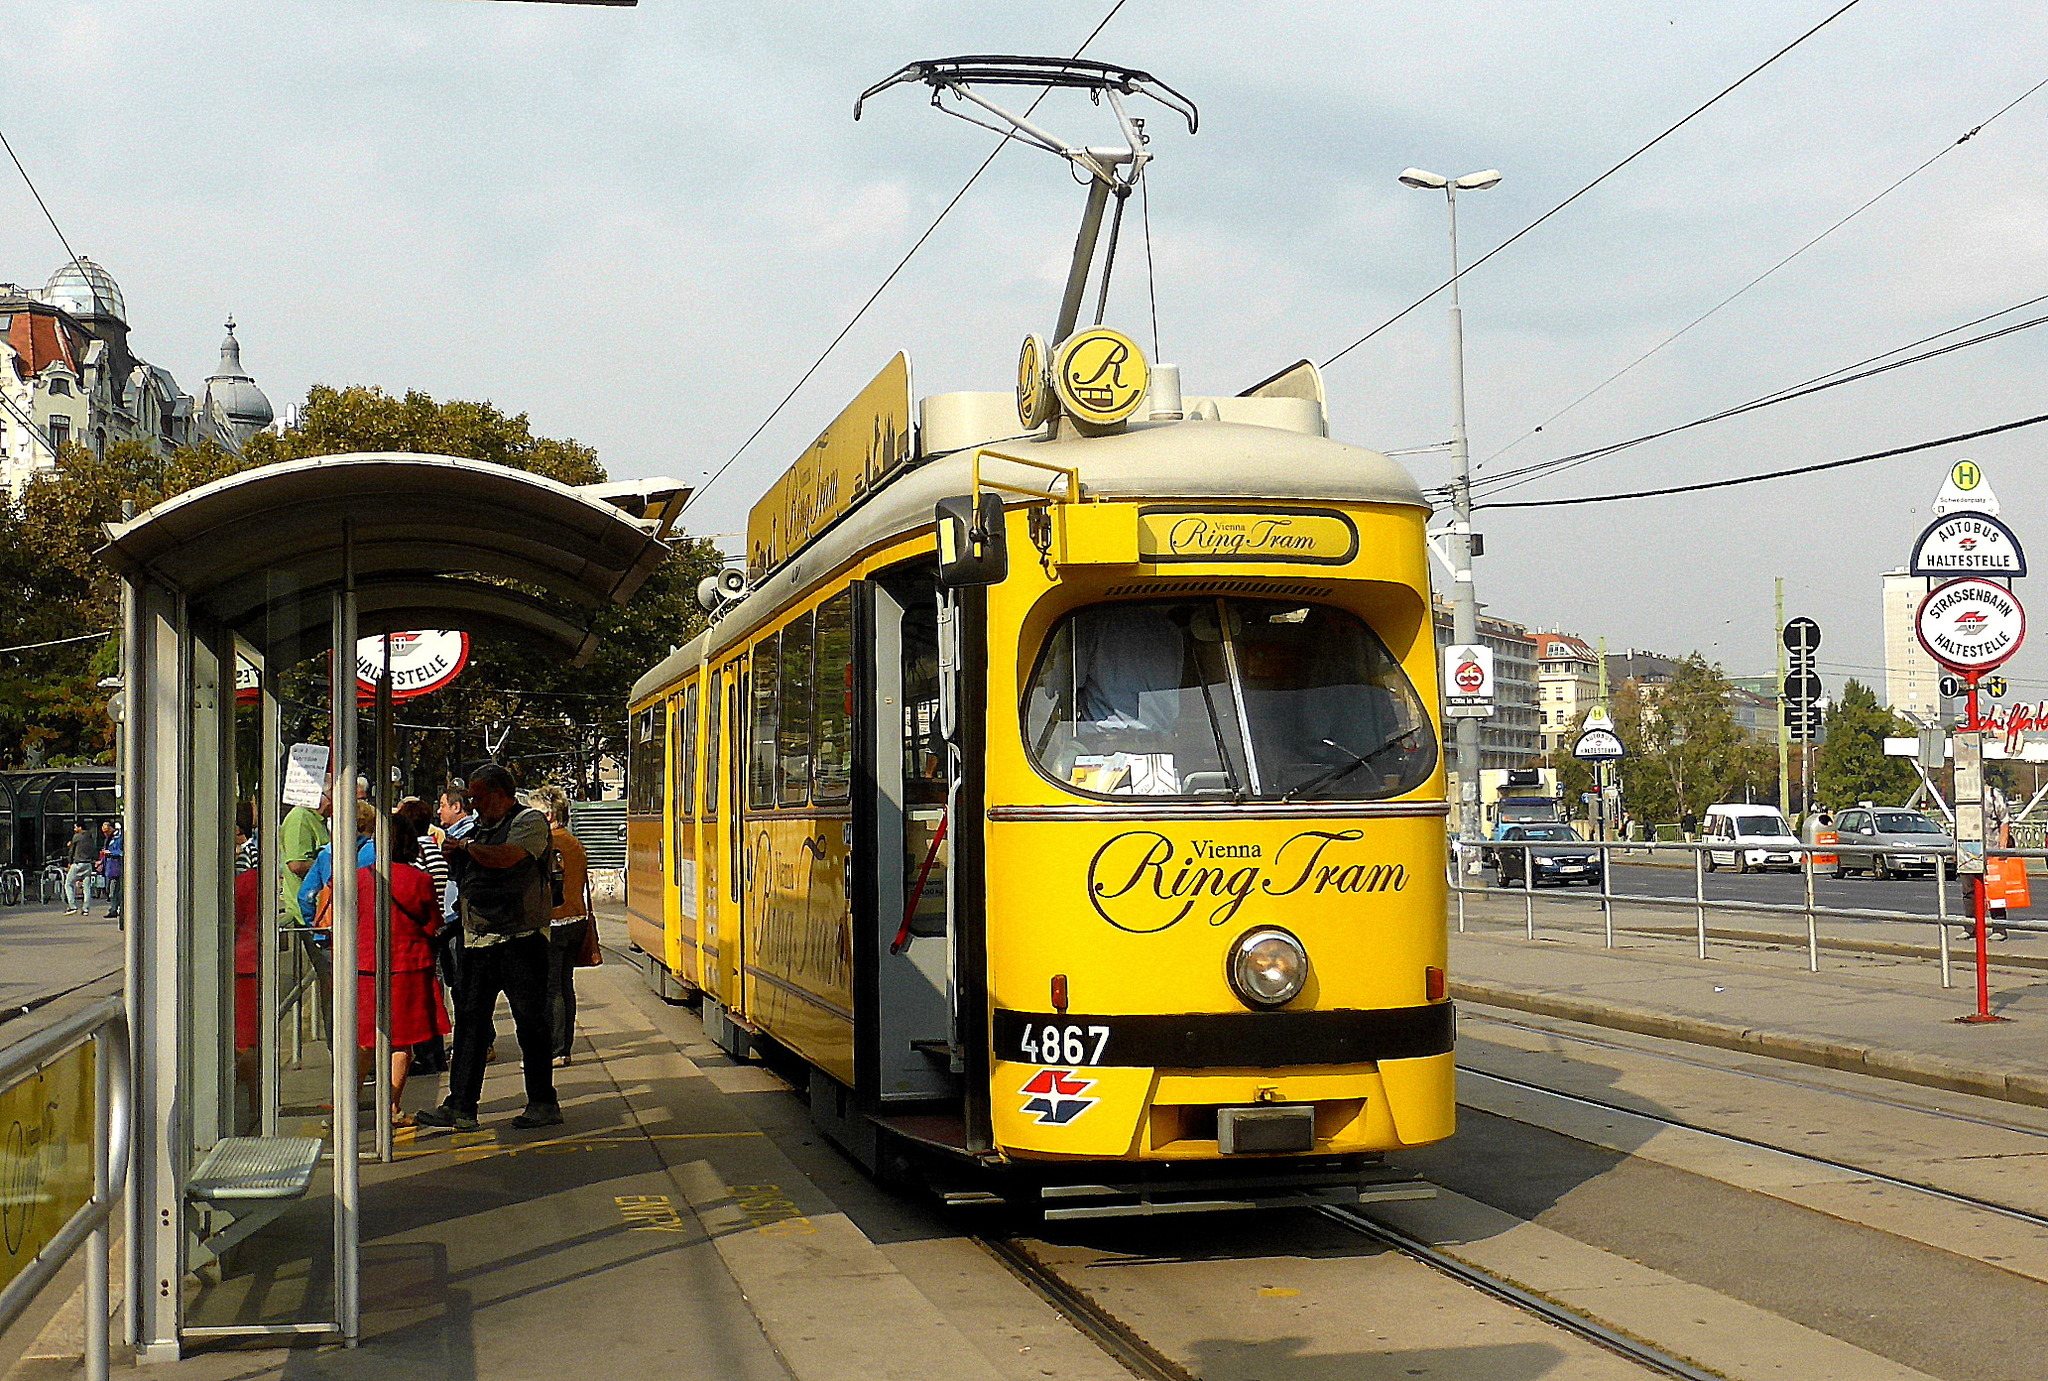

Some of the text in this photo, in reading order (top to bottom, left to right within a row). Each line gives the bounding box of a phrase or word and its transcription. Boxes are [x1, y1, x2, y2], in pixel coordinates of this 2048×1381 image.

[1063, 337, 1138, 411] R
[1959, 466, 1973, 484] H
[1170, 518, 1316, 554] Ring Tram
[1215, 522, 1245, 531] Vienna
[1939, 522, 1999, 542] AUTOBUS
[1927, 555, 2010, 567] HALTESTELLE
[1930, 588, 2013, 619] STRASSENBAHN
[1934, 631, 2011, 658] HALTESTELLE
[1943, 679, 1952, 695] 1
[1992, 683, 2002, 696] N
[1191, 840, 1262, 858] Vienna
[1088, 830, 1410, 933] Ring Tram
[1021, 1023, 1110, 1065] 4867
[614, 1195, 687, 1233] ENTRY
